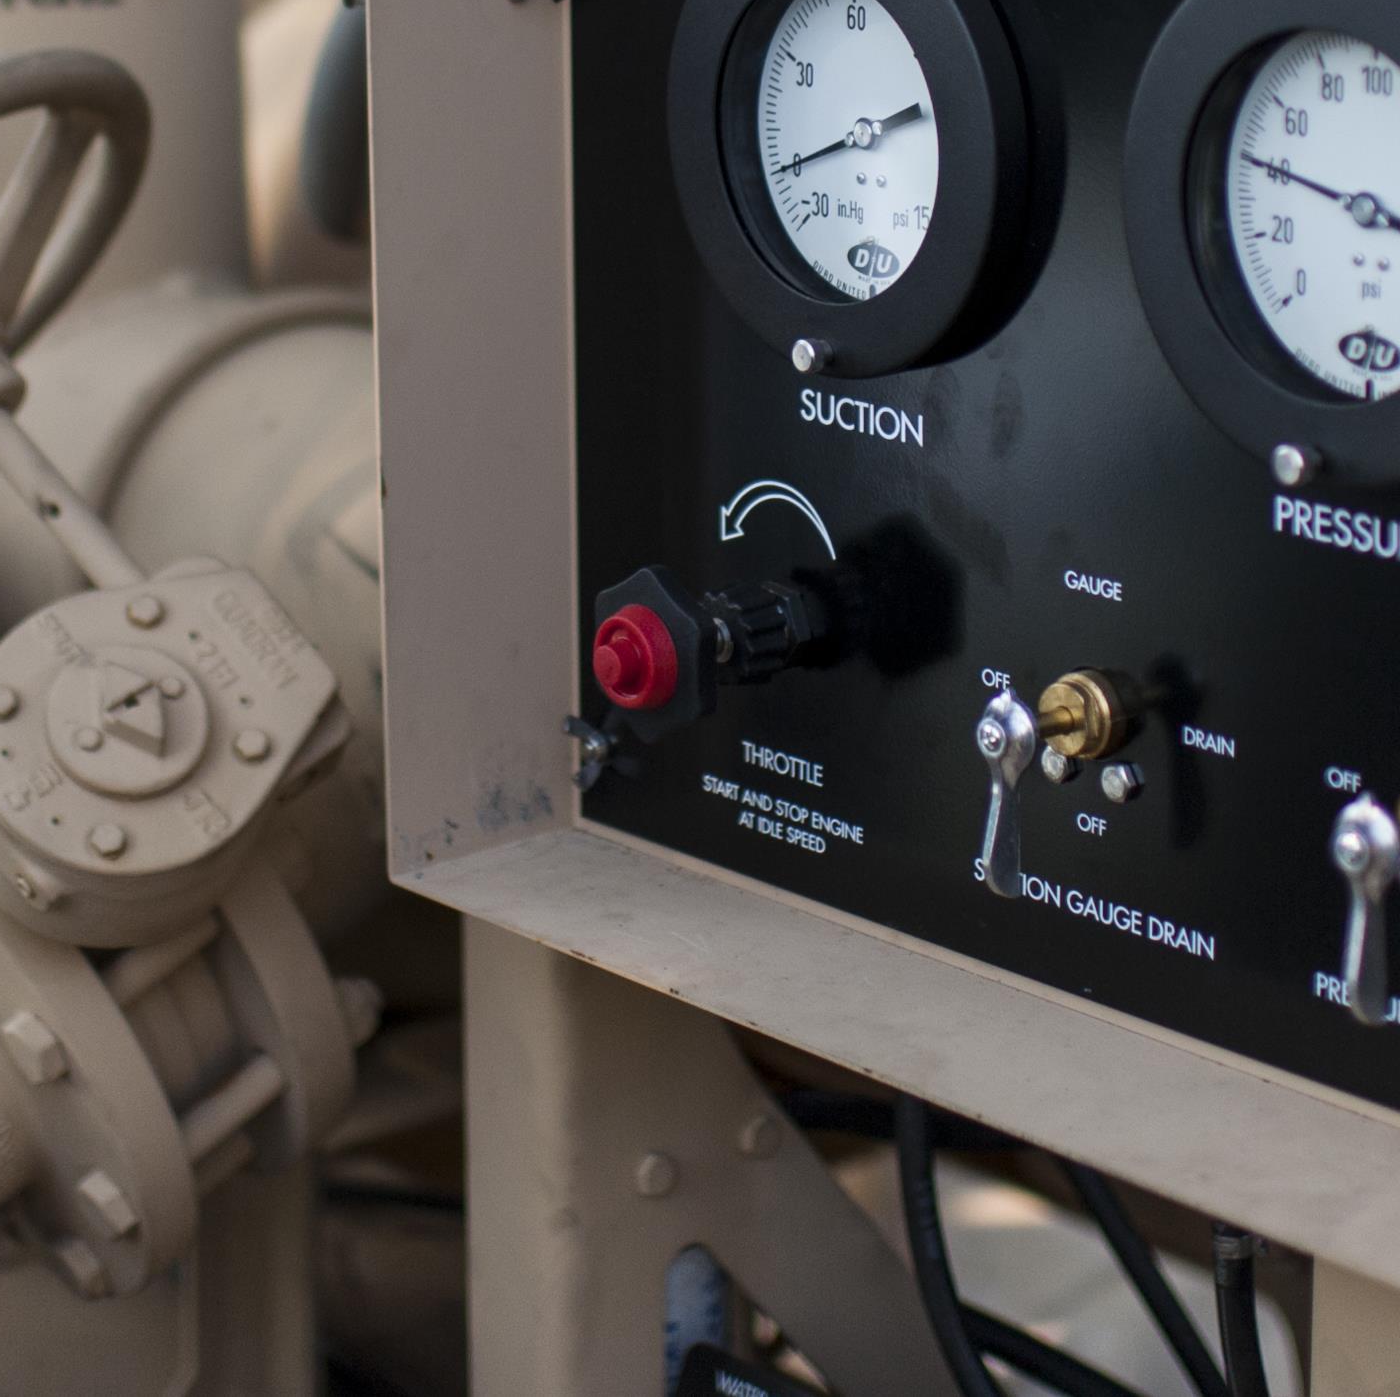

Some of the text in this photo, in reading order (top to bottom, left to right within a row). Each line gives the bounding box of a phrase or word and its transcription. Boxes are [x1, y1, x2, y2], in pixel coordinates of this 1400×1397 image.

[847, 5, 866, 31] 60
[796, 62, 814, 88] 30
[1322, 73, 1344, 102] 80
[1362, 66, 1393, 97] 100
[1285, 109, 1308, 137] 60
[793, 153, 801, 177] 0
[1267, 159, 1291, 186] 40
[811, 192, 864, 224] 30 in.Hg
[893, 211, 909, 230] psi
[1271, 216, 1294, 245] 20
[837, 278, 867, 300] UNITED
[1296, 269, 1306, 296] 0
[1361, 278, 1382, 299] psi
[800, 389, 924, 448] SUCTION
[1064, 570, 1122, 602] GAUGE
[981, 668, 1011, 690] OFF
[1183, 726, 1235, 758] DRAIN
[741, 740, 823, 787] THROTTLE
[1324, 766, 1361, 793] OFF
[703, 775, 864, 845] START AND STOP ENGINE
[738, 811, 826, 854] AT IDLE SPEED
[1077, 813, 1107, 836] OFF
[974, 859, 1215, 960] SION GAUGE DRAIN
